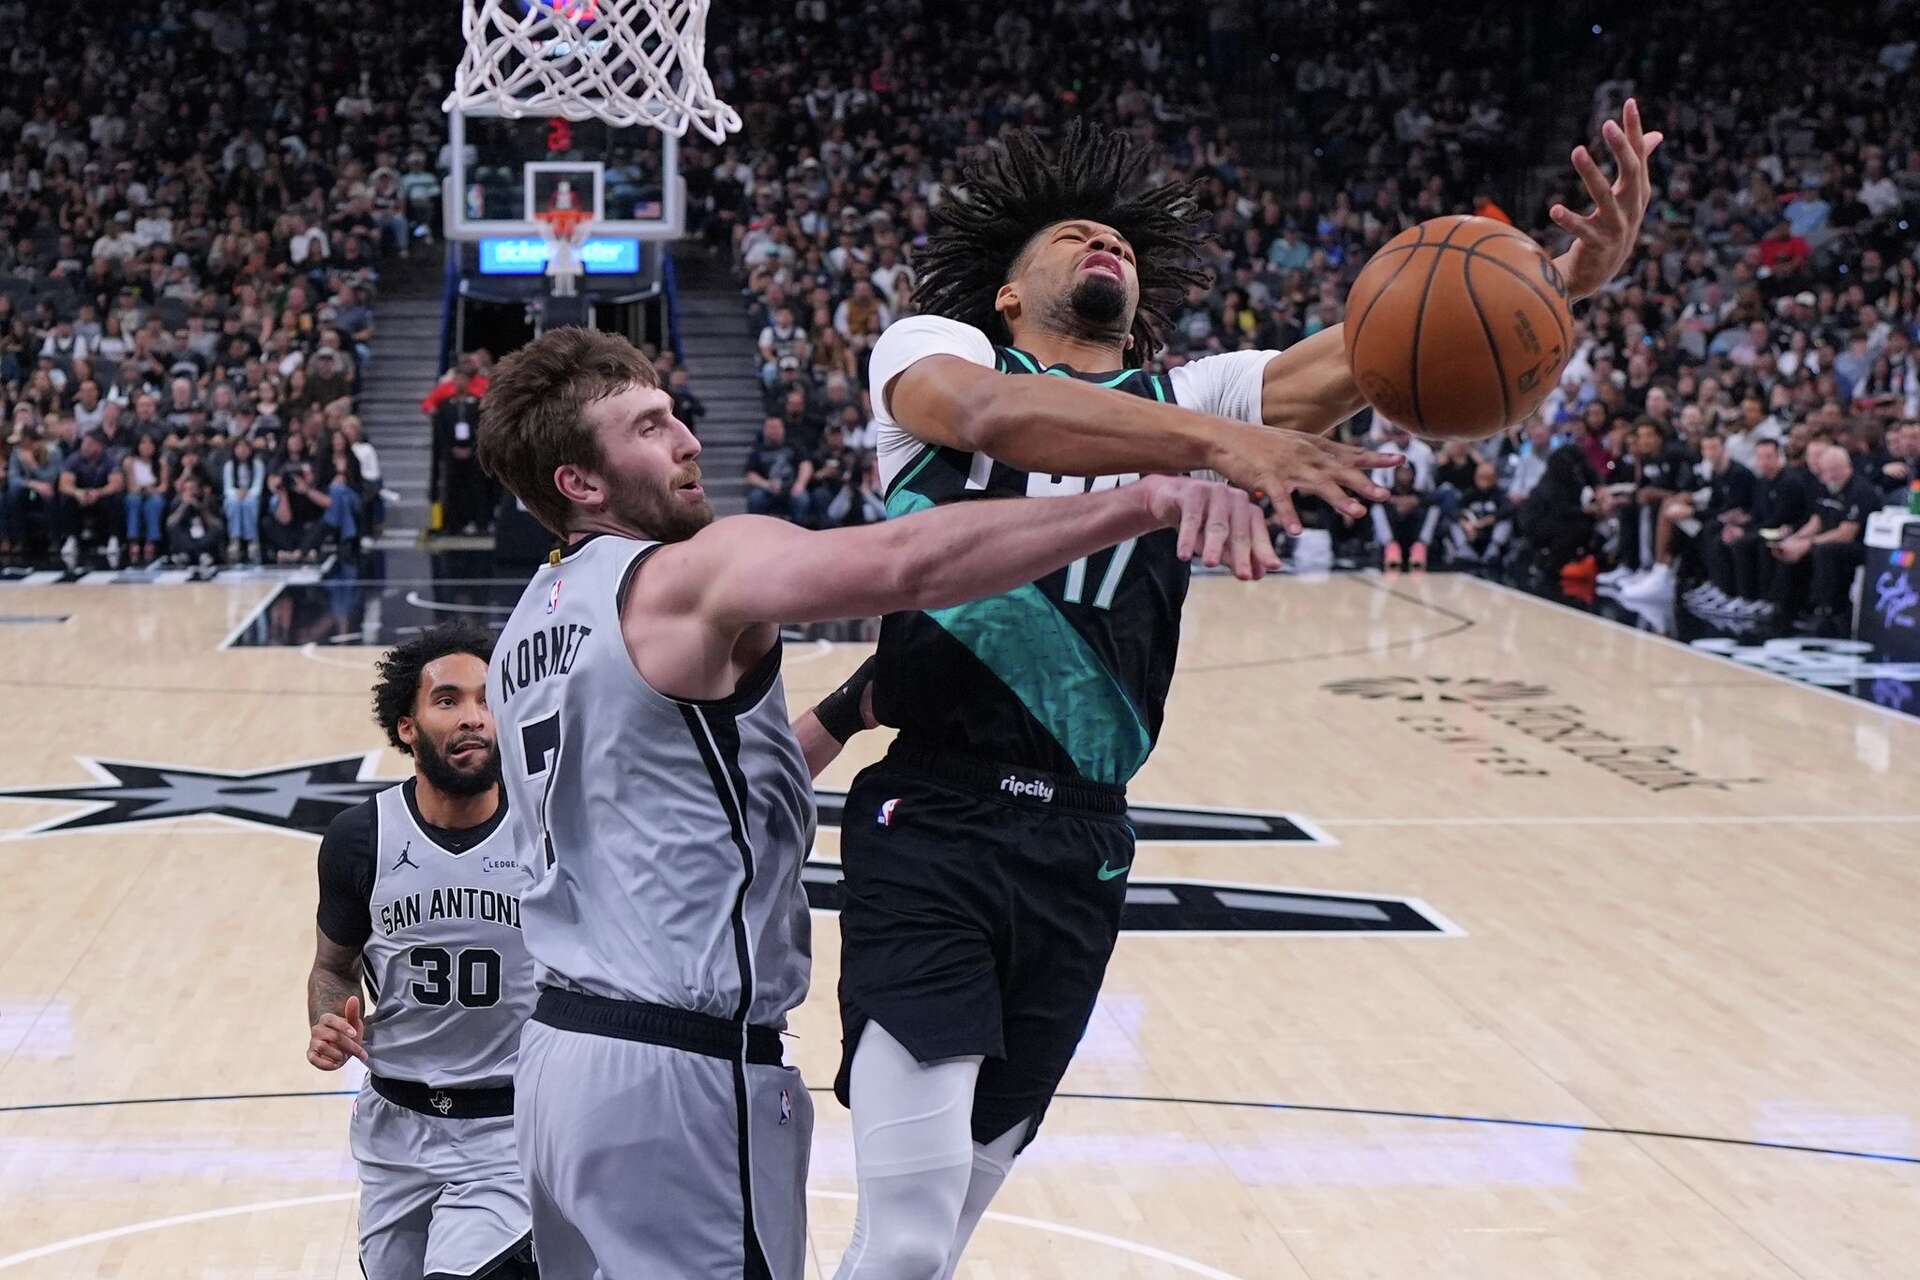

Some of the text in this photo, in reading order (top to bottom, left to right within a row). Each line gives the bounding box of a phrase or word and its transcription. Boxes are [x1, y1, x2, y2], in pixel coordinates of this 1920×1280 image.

[501, 624, 592, 704] KORNET
[518, 709, 562, 872] 7
[1000, 775, 1054, 802] ripcity
[489, 860, 519, 869] LEDGE
[381, 887, 522, 936] SAN ANTONI
[409, 946, 502, 1008] 30
